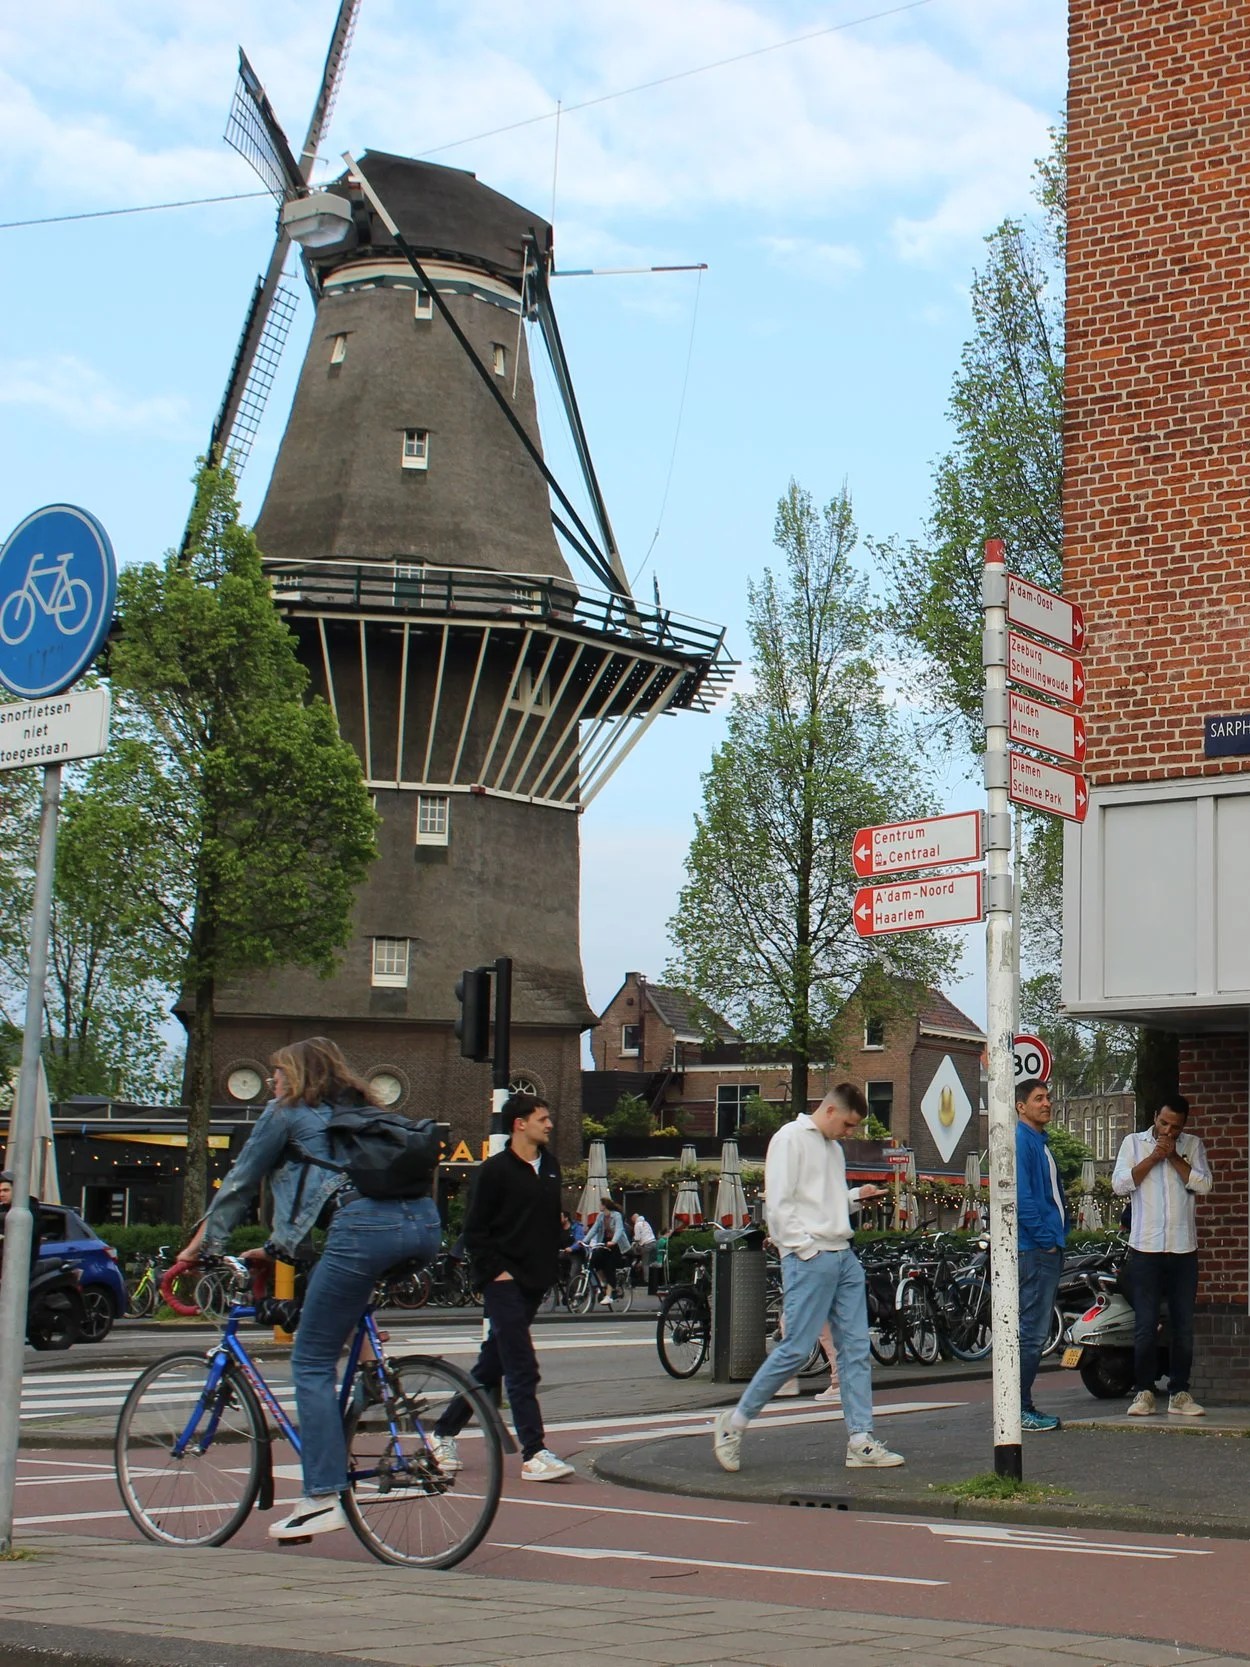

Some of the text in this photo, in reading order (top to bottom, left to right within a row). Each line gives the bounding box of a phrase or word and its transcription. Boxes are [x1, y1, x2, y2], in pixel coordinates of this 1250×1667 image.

[1009, 581, 1053, 611] A'dam-Oost
[1011, 638, 1042, 664] Zeeburg
[1011, 659, 1069, 692] Schellingwoude
[0, 703, 71, 723] snorfietsen
[1012, 698, 1040, 718] Muiden
[24, 724, 48, 739] niet
[1012, 719, 1040, 738] Almere
[0, 742, 69, 763] toegestaan
[1012, 758, 1041, 778] Diemen
[1012, 779, 1062, 805] Science Park
[874, 828, 925, 844] Centrum
[889, 844, 940, 863] Centraal
[875, 882, 954, 904] A'dam-Noord
[875, 909, 925, 925] Haarlem
